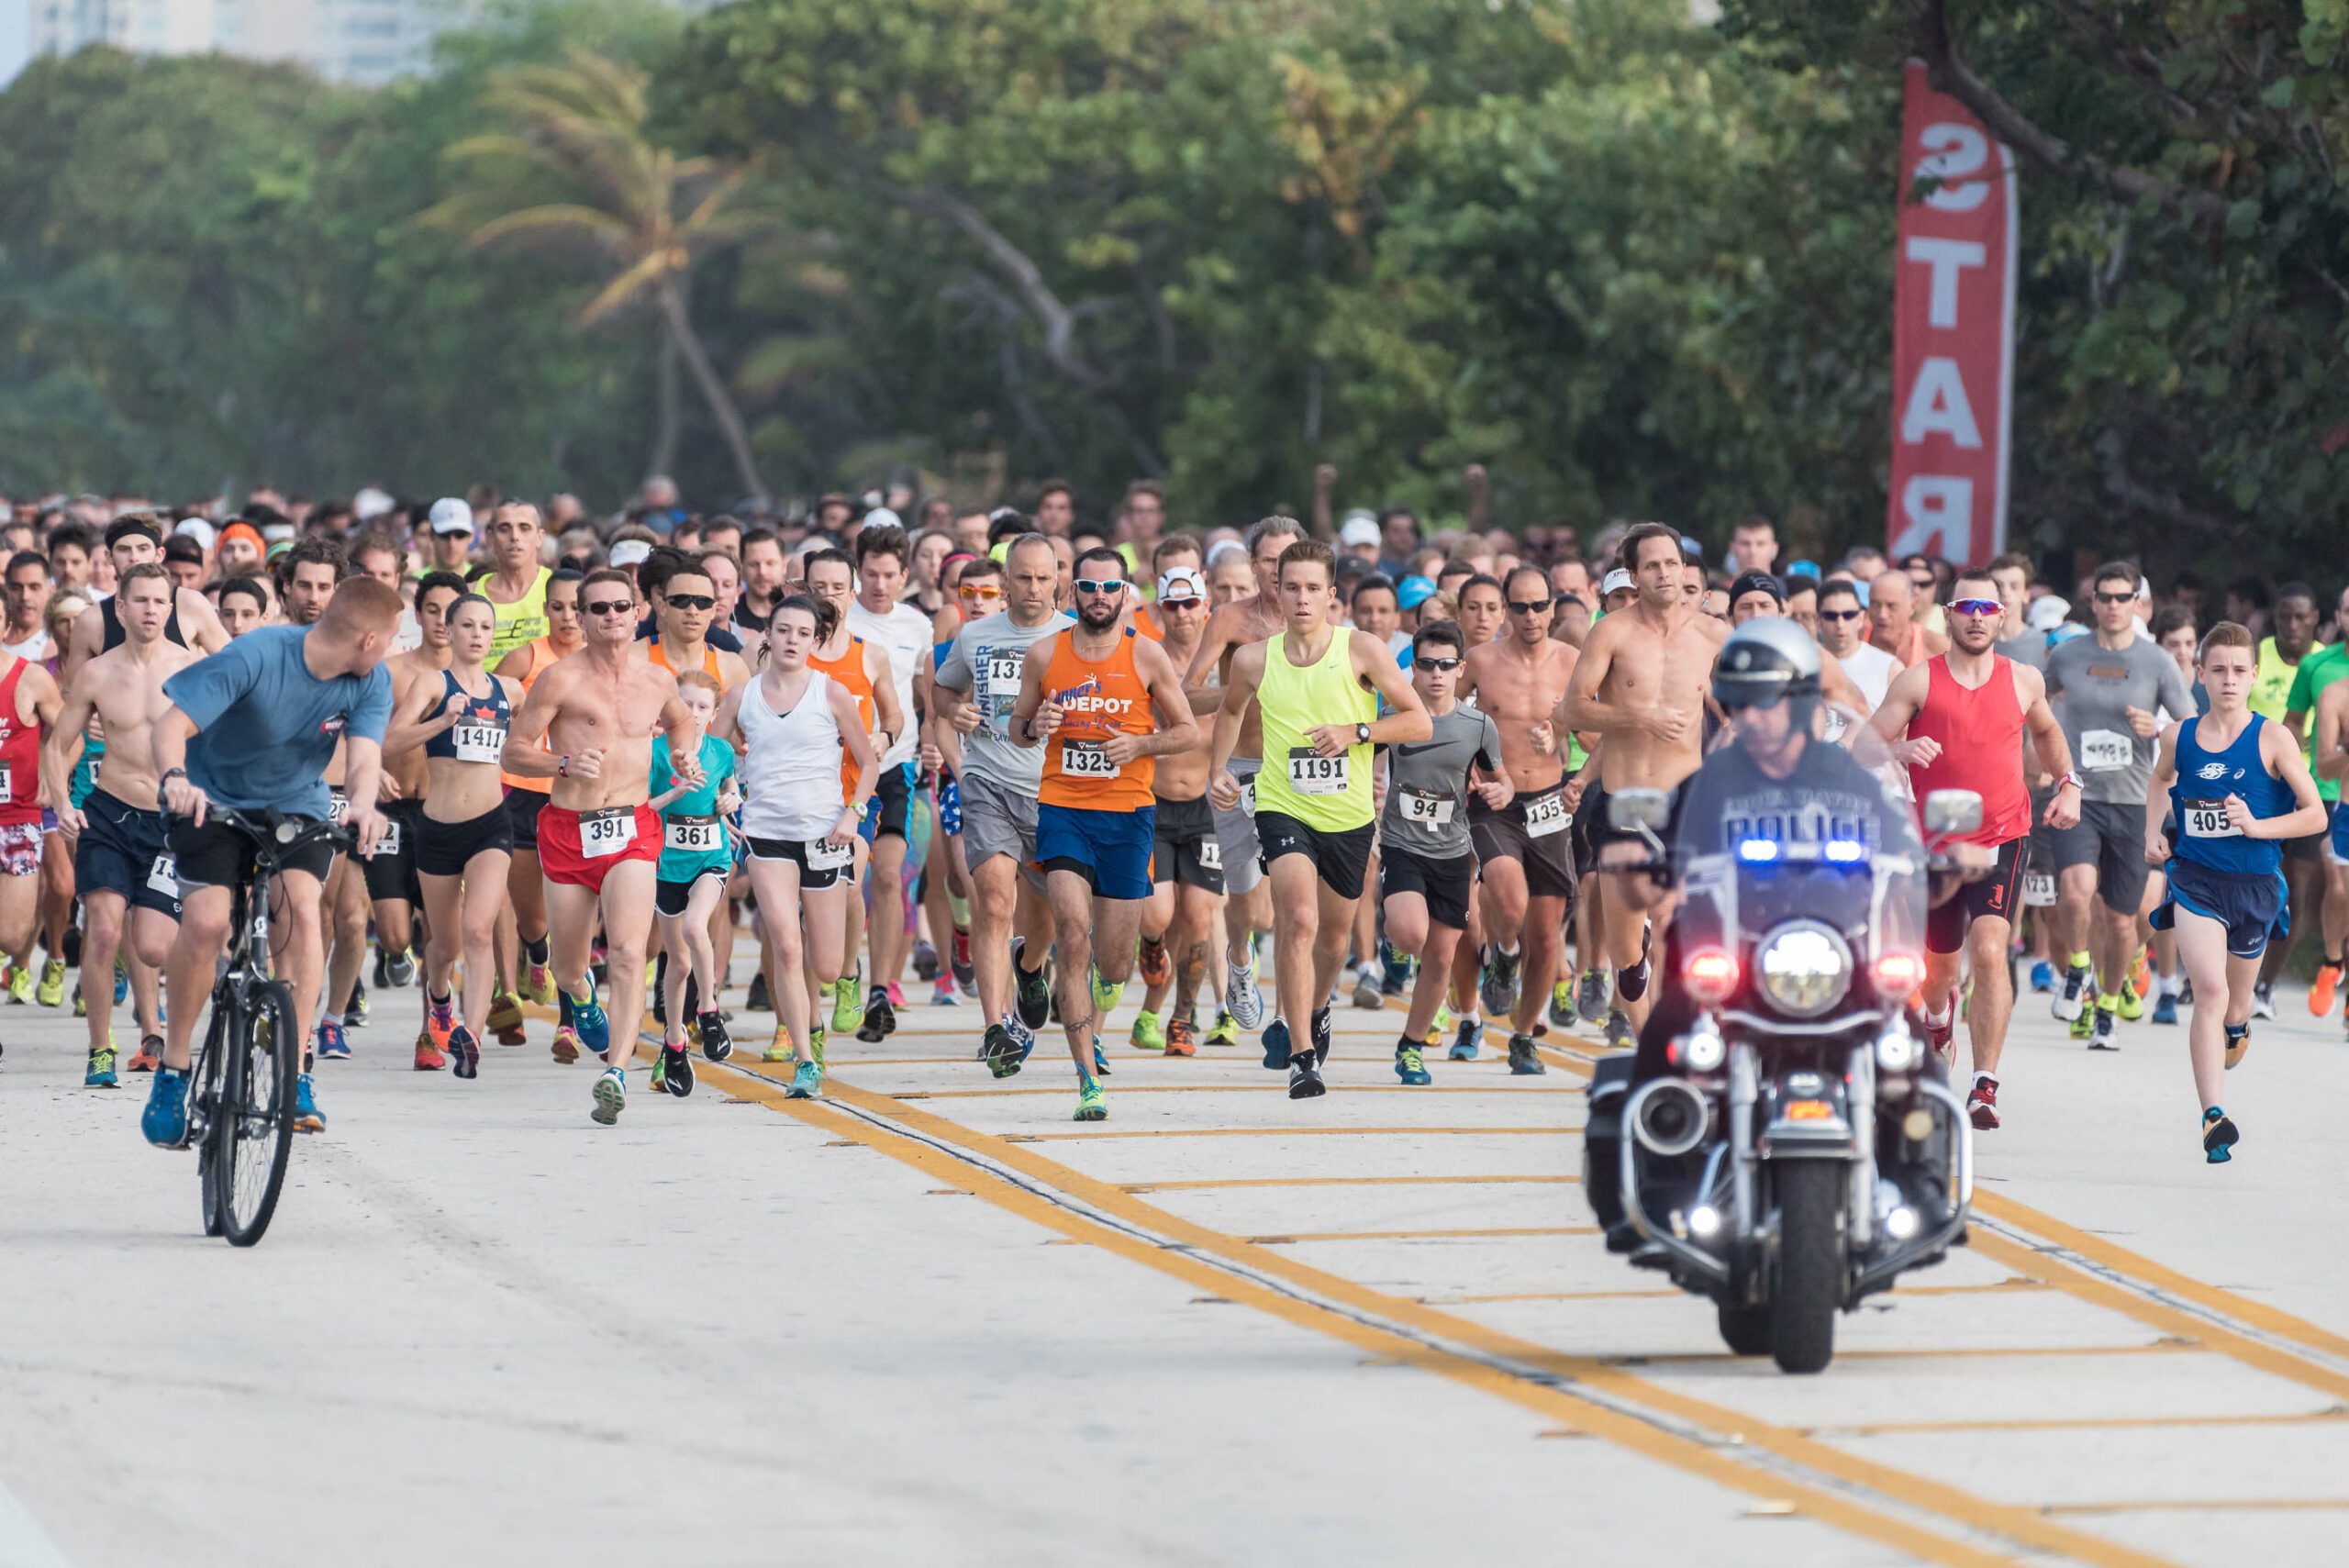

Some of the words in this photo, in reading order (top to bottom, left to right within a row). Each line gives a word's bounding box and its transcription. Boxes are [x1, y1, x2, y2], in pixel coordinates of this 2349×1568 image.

[1063, 695, 1133, 714] DEPOT
[462, 728, 501, 749] 1411
[1065, 751, 1115, 772] 1325
[1294, 759, 1344, 779] 1191
[1413, 799, 1438, 818] 94
[590, 817, 625, 840] 391
[2193, 811, 2232, 831] 405
[675, 826, 711, 845] 361
